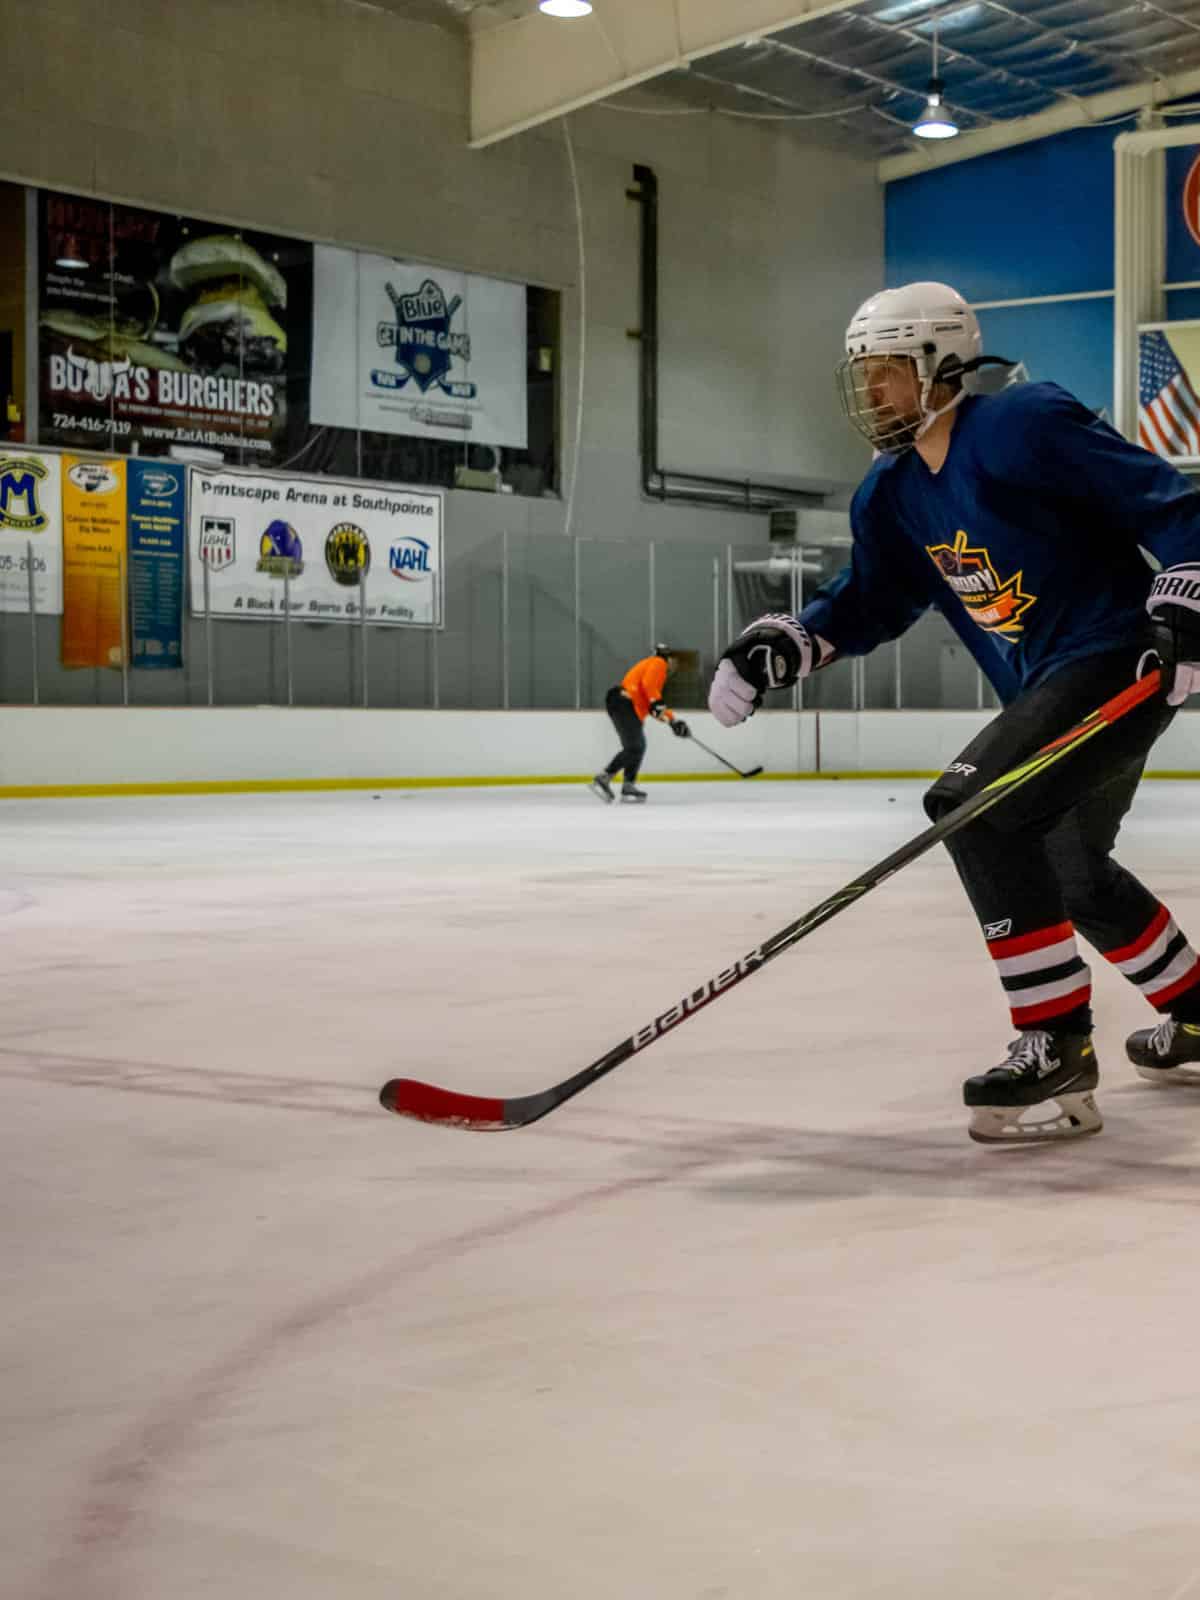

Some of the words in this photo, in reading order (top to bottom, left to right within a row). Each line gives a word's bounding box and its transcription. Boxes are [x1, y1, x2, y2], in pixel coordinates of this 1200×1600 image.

[404, 299, 442, 319] Blue
[158, 369, 275, 417] BURGHERS
[201, 481, 280, 503] Printscape
[285, 487, 327, 506] Arena
[332, 493, 348, 507] at
[352, 494, 434, 517] Southpointe
[390, 547, 432, 572] NAHL
[234, 597, 243, 609] A
[345, 602, 376, 615] Grup
[633, 945, 767, 1051] BAUER
